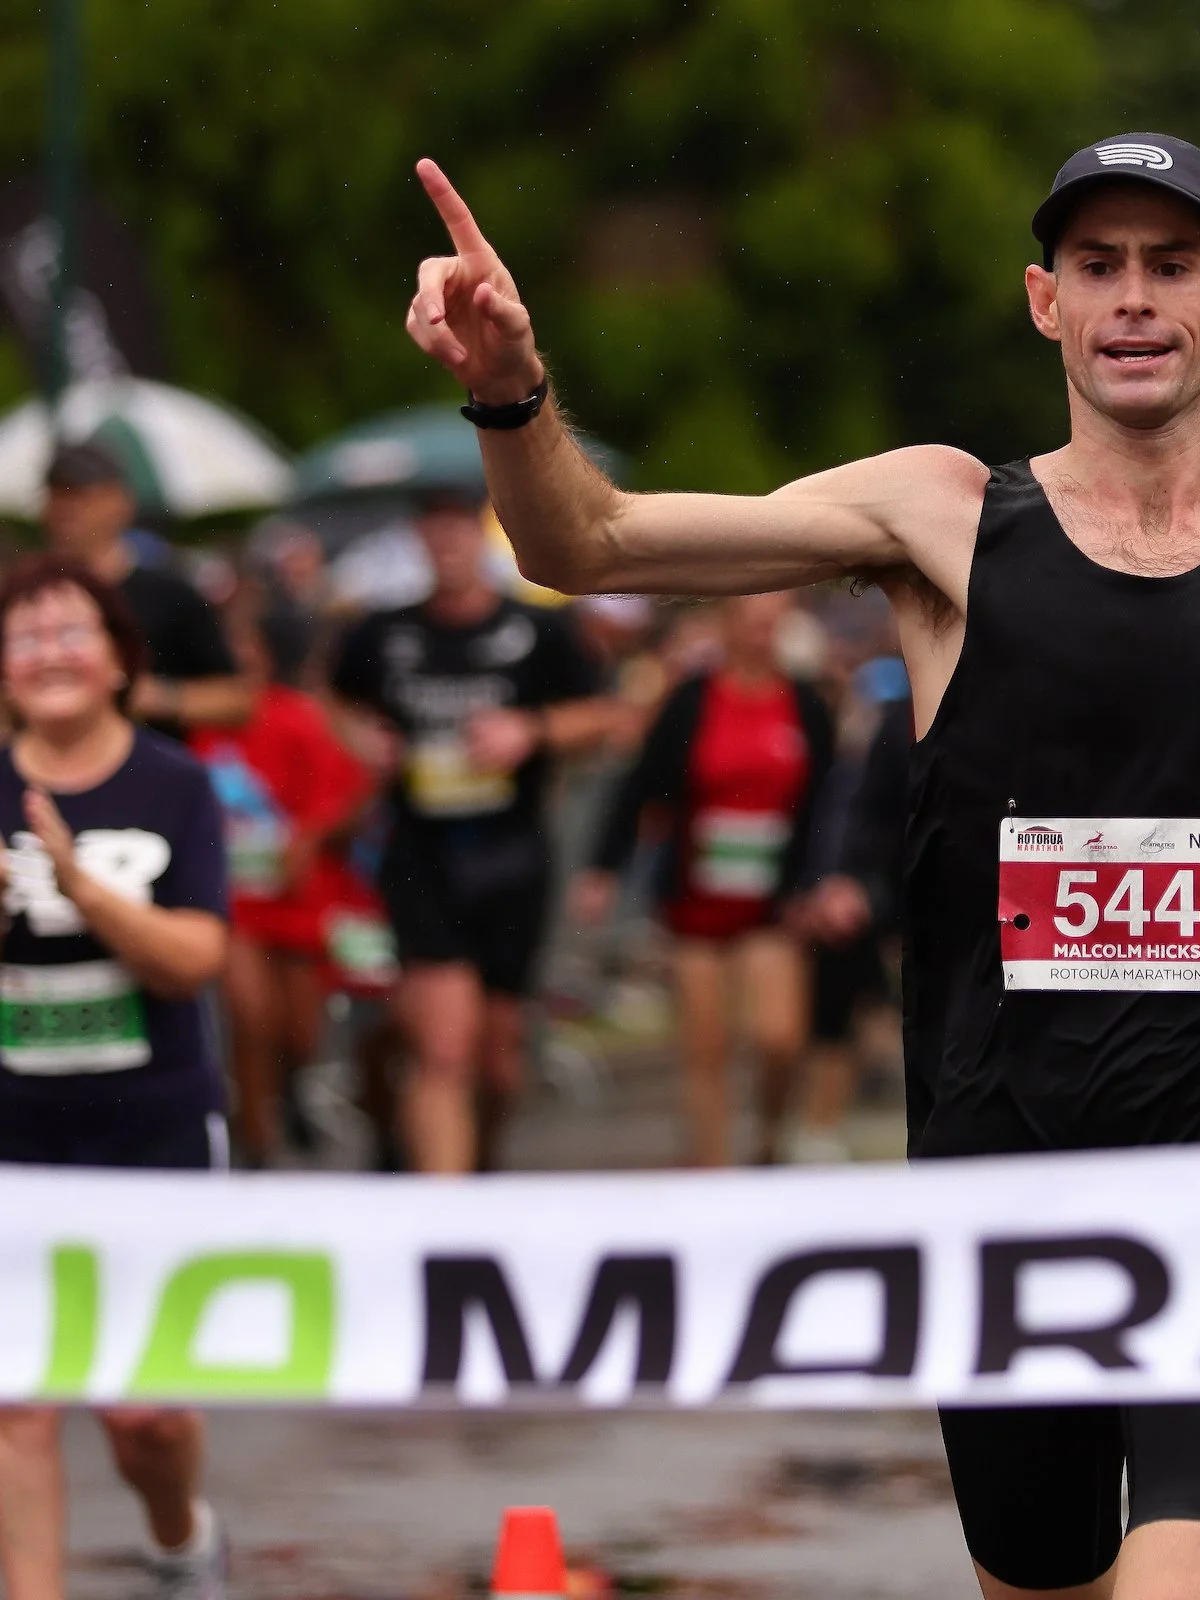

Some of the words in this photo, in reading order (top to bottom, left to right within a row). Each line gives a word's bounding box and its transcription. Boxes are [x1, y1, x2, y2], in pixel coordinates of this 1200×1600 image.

[1017, 833, 1064, 844] ROTORUA
[1054, 869, 1200, 937] 544
[1054, 943, 1142, 958] MALCOLM
[1147, 944, 1200, 958] HICKS
[1050, 968, 1119, 980] ROTORUA
